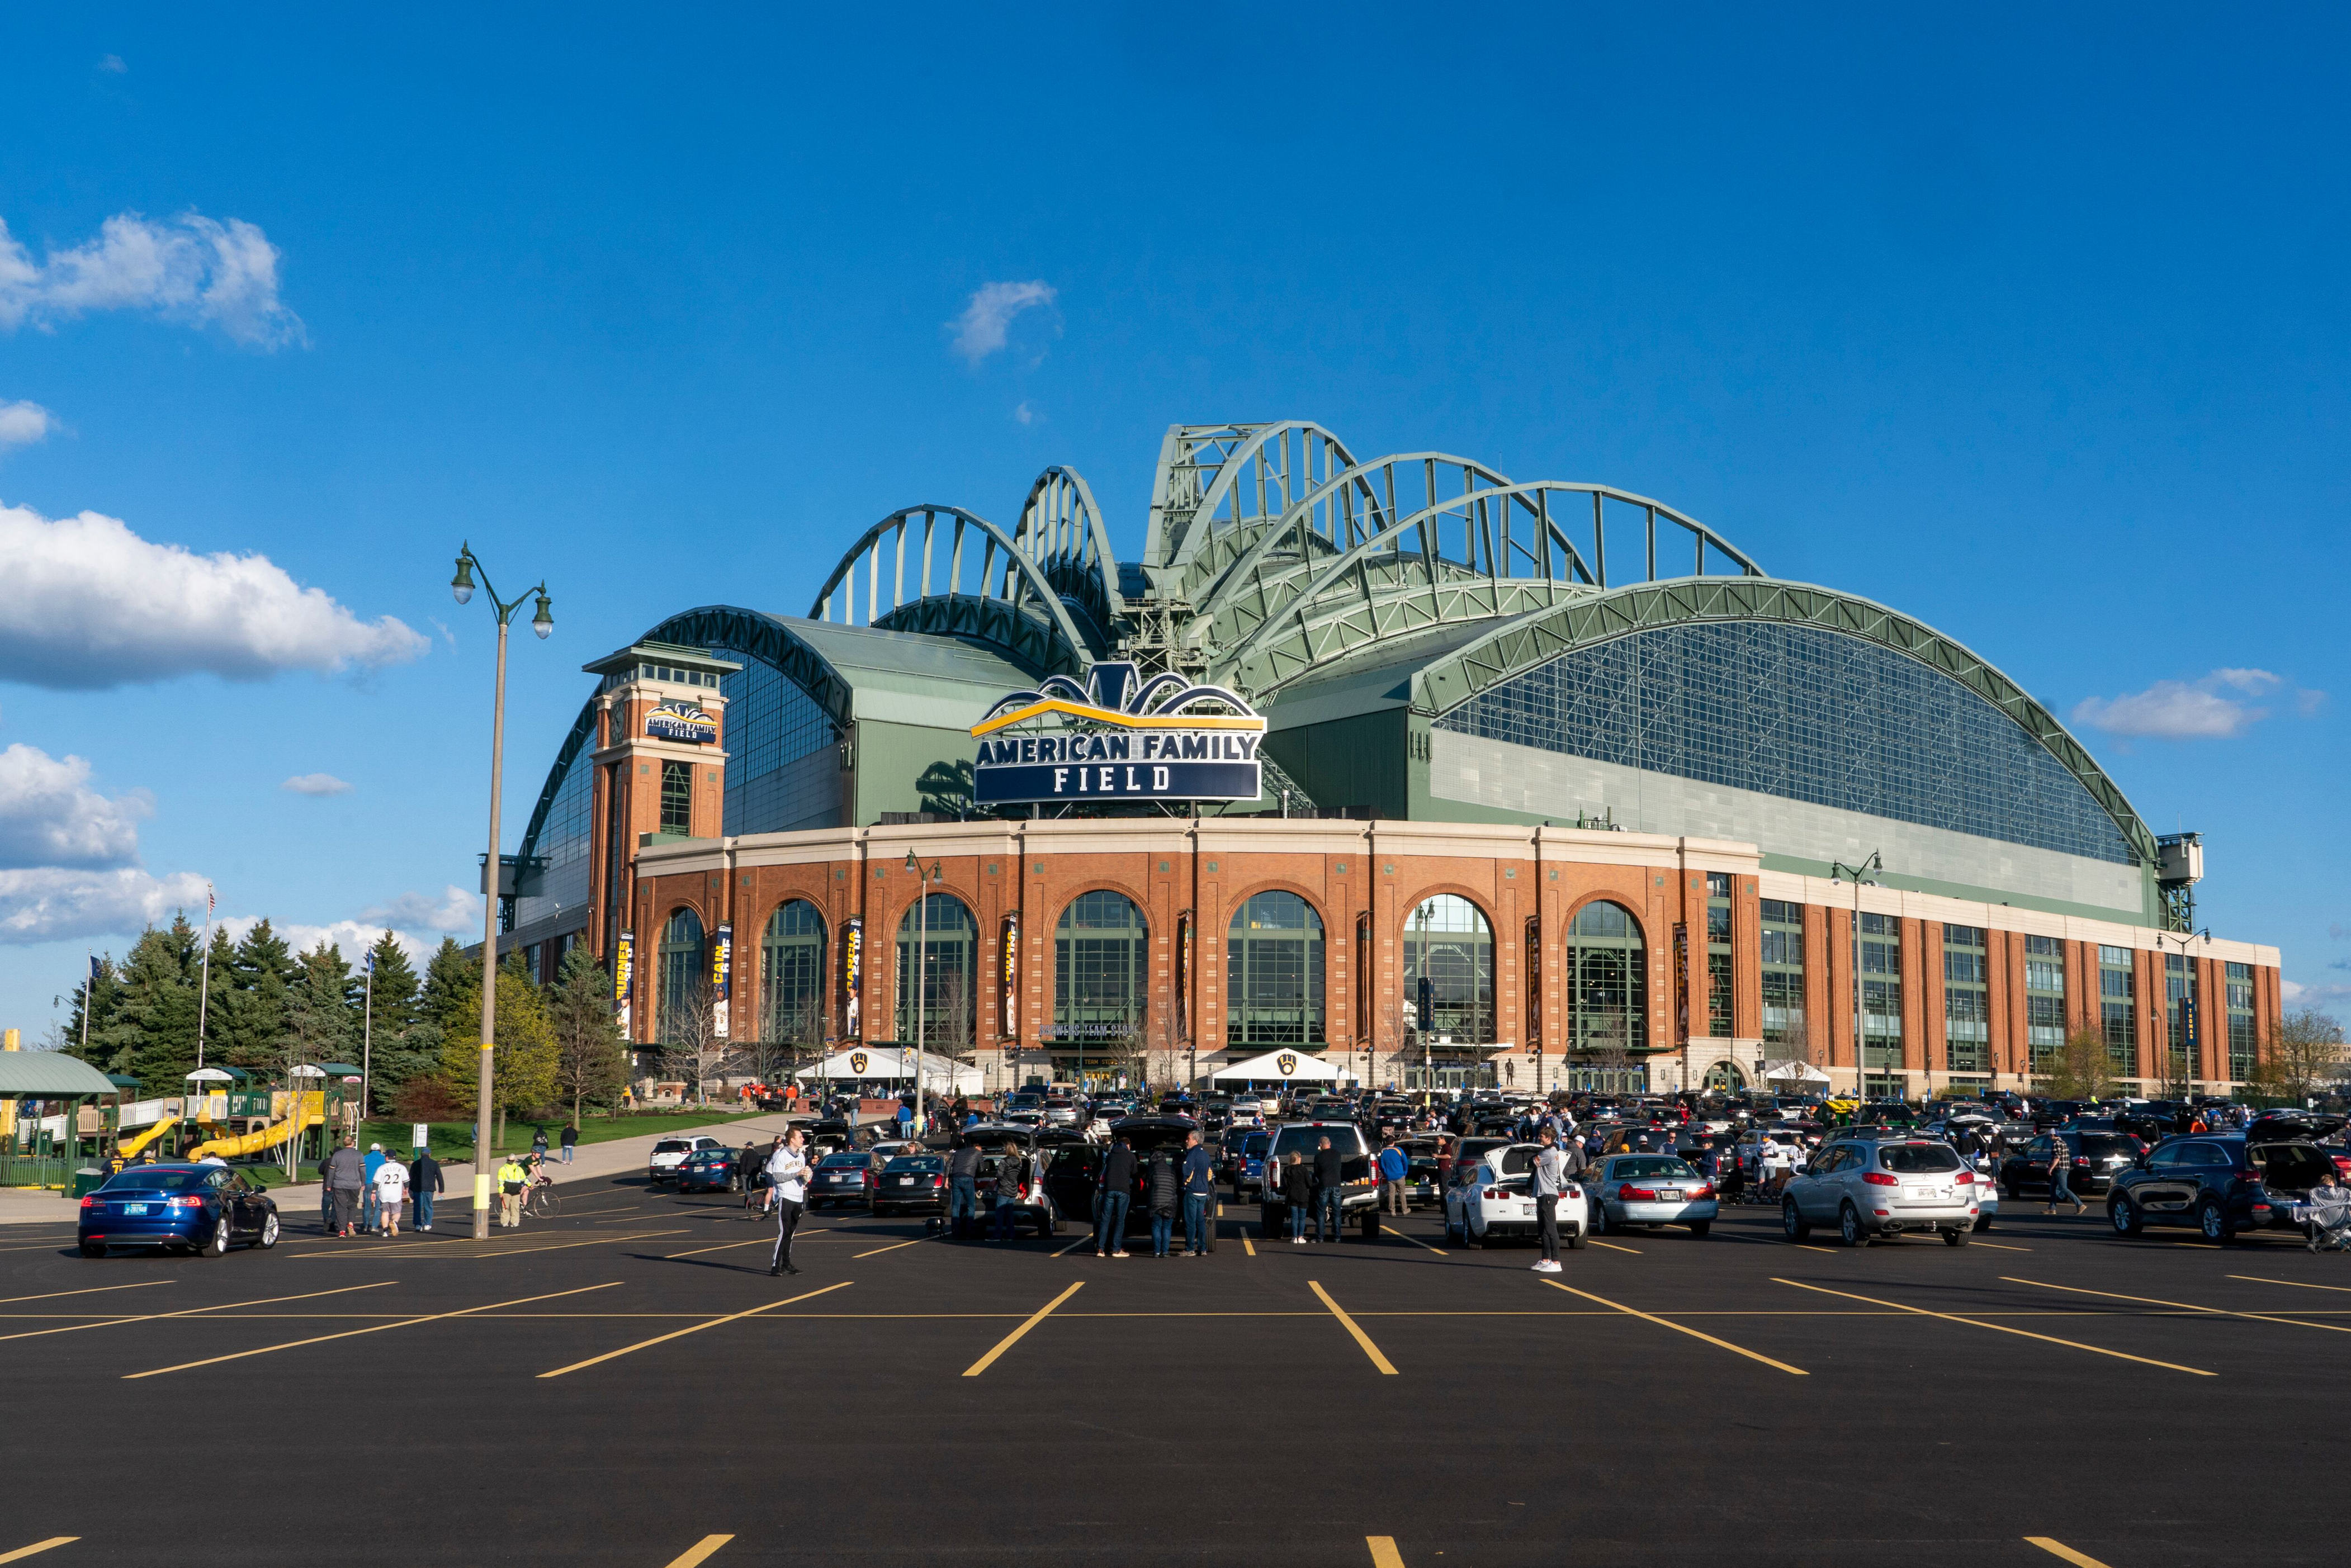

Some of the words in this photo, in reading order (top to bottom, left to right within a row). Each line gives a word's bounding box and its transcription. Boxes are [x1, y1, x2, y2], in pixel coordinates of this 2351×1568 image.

[648, 718, 687, 729] AMERICAN
[690, 724, 716, 734] FAMILY
[669, 728, 697, 738] FIELD
[977, 734, 1130, 765] AMERICAN
[1144, 732, 1257, 760] FAMILY
[1054, 766, 1169, 792] FIELD
[616, 940, 630, 1001] BURNES
[713, 945, 725, 984] CAIN
[1039, 1024, 1080, 1036] BREWERS
[1084, 1025, 1108, 1036] TEAM
[1110, 1025, 1139, 1036] STORE
[384, 1173, 399, 1184] 22
